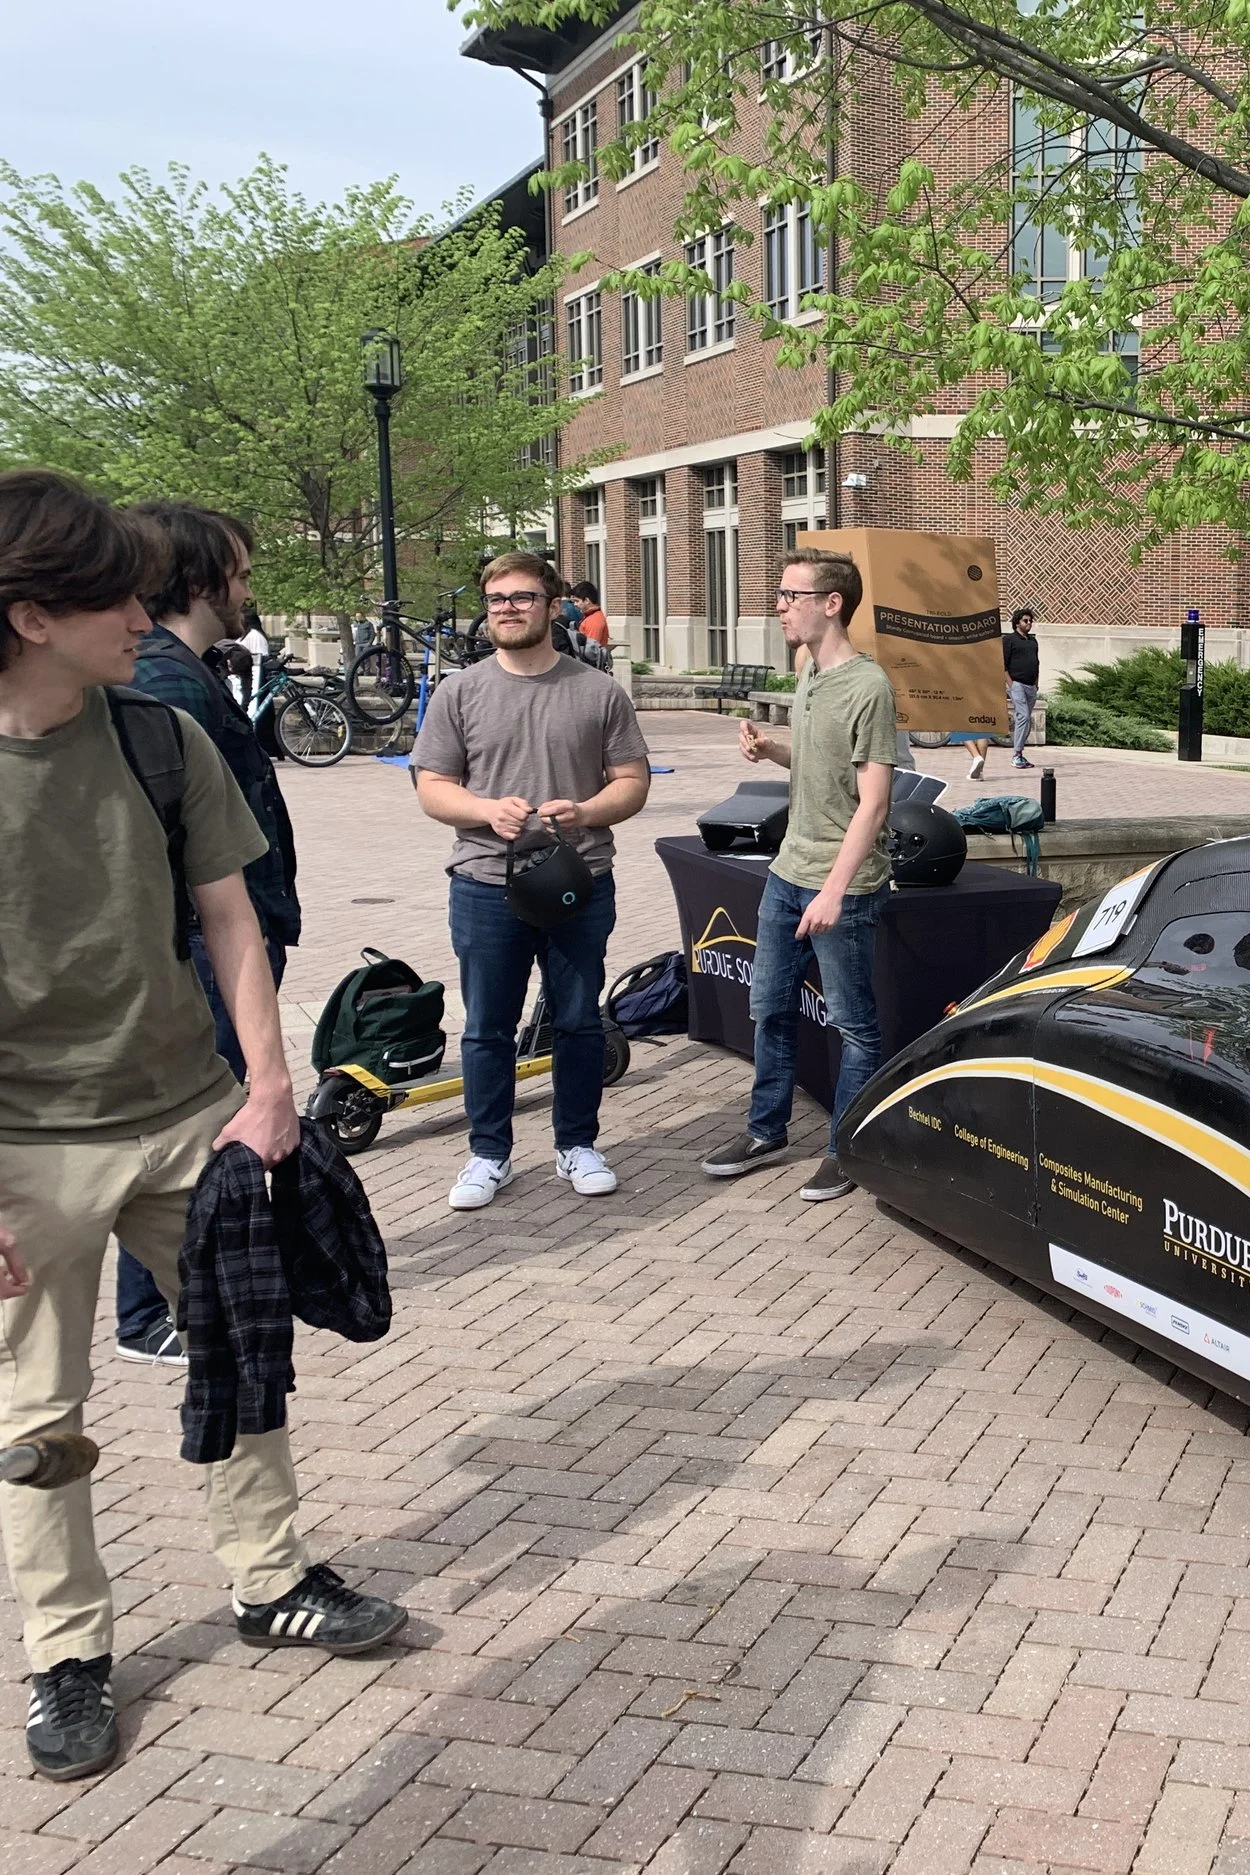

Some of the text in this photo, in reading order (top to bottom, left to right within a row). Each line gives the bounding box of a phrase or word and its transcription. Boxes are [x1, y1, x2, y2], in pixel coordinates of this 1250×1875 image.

[880, 611, 997, 634] PRESENTATION BOARD
[1196, 628, 1204, 697] EMERGENCY
[968, 715, 996, 726] enday
[1093, 900, 1127, 931] 719
[694, 948, 735, 981] PURDUE
[908, 1105, 942, 1132] Bechtel IDC
[954, 1124, 1029, 1172] College of Engineering
[1039, 1152, 1143, 1213] Composites Manufacturing
[1050, 1178, 1130, 1225] & Simulation Center
[1210, 1338, 1230, 1353] ALTAIR
